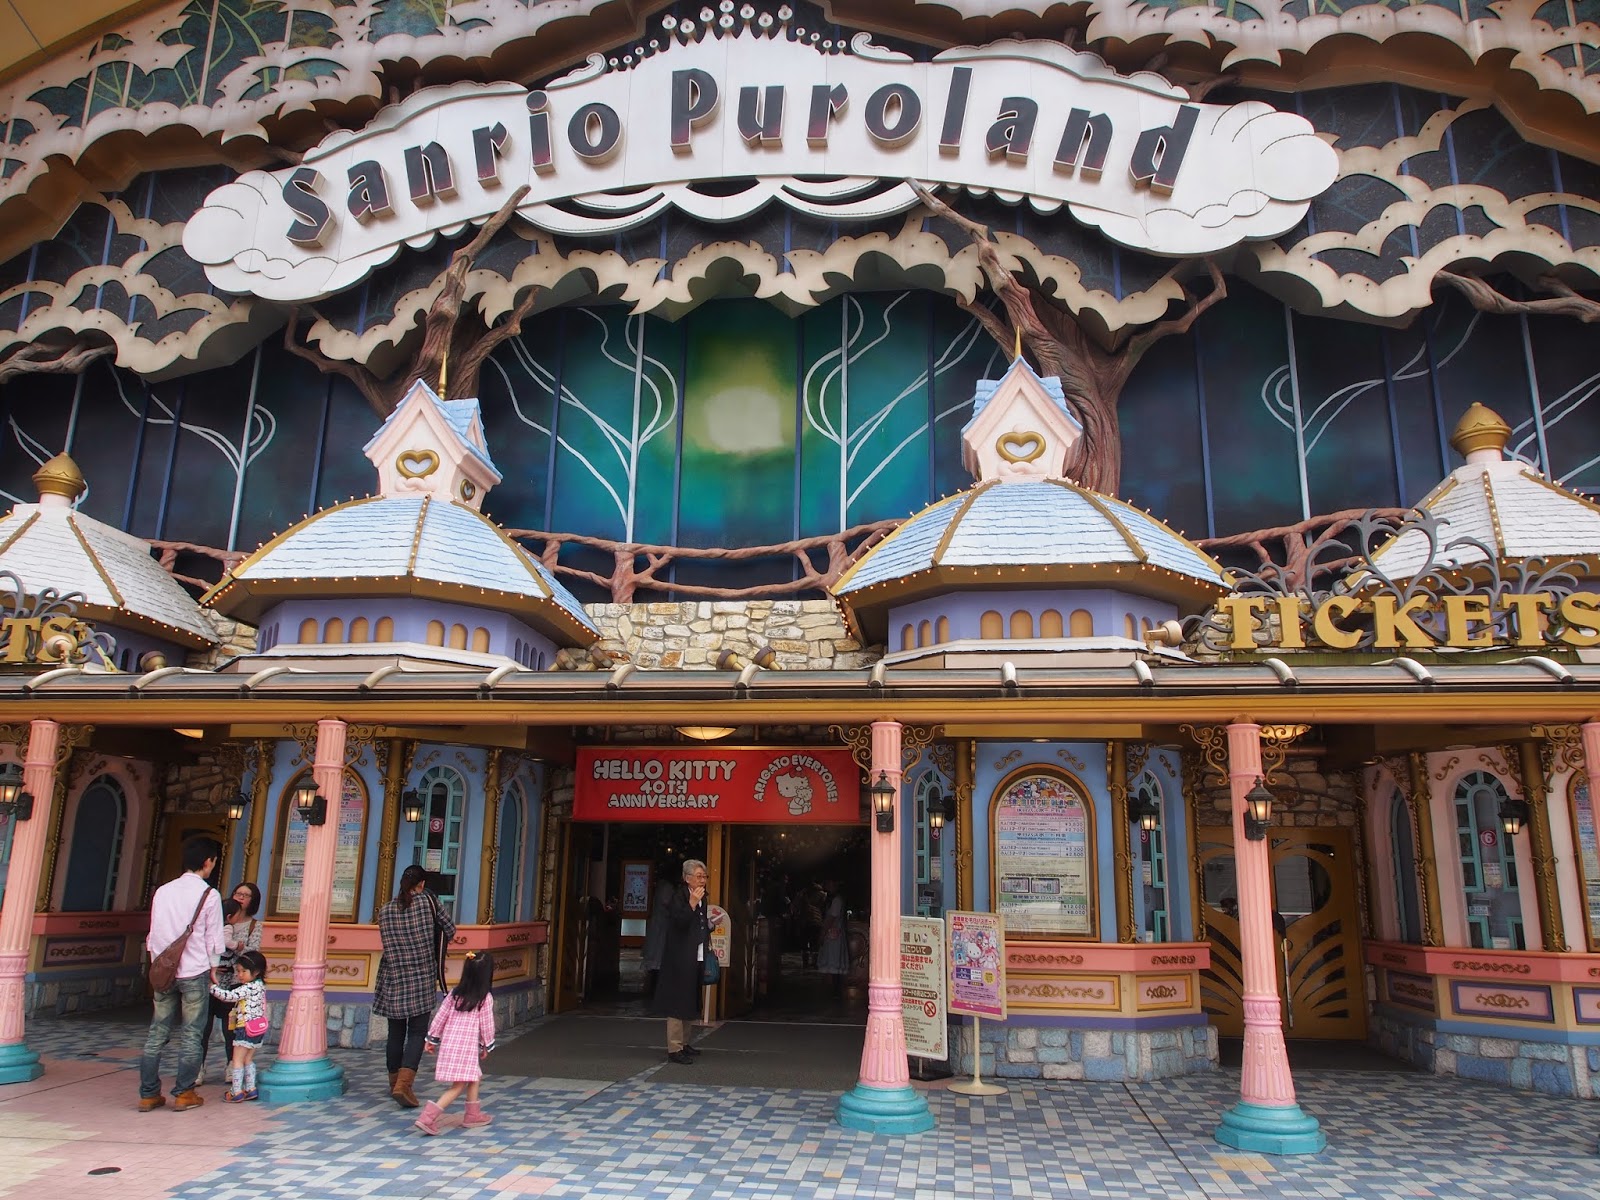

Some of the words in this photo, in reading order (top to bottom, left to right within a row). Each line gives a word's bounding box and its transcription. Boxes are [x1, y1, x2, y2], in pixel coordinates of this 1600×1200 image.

[282, 90, 625, 248] Sanrio
[670, 66, 1202, 196] Puroland
[1218, 592, 1600, 650] TICKETS
[593, 759, 664, 780] HELLO
[669, 760, 737, 780] KITTY
[753, 756, 791, 803] ARIGATO
[607, 793, 720, 808] ANNIVERSARY
[640, 780, 688, 794] 40TH
